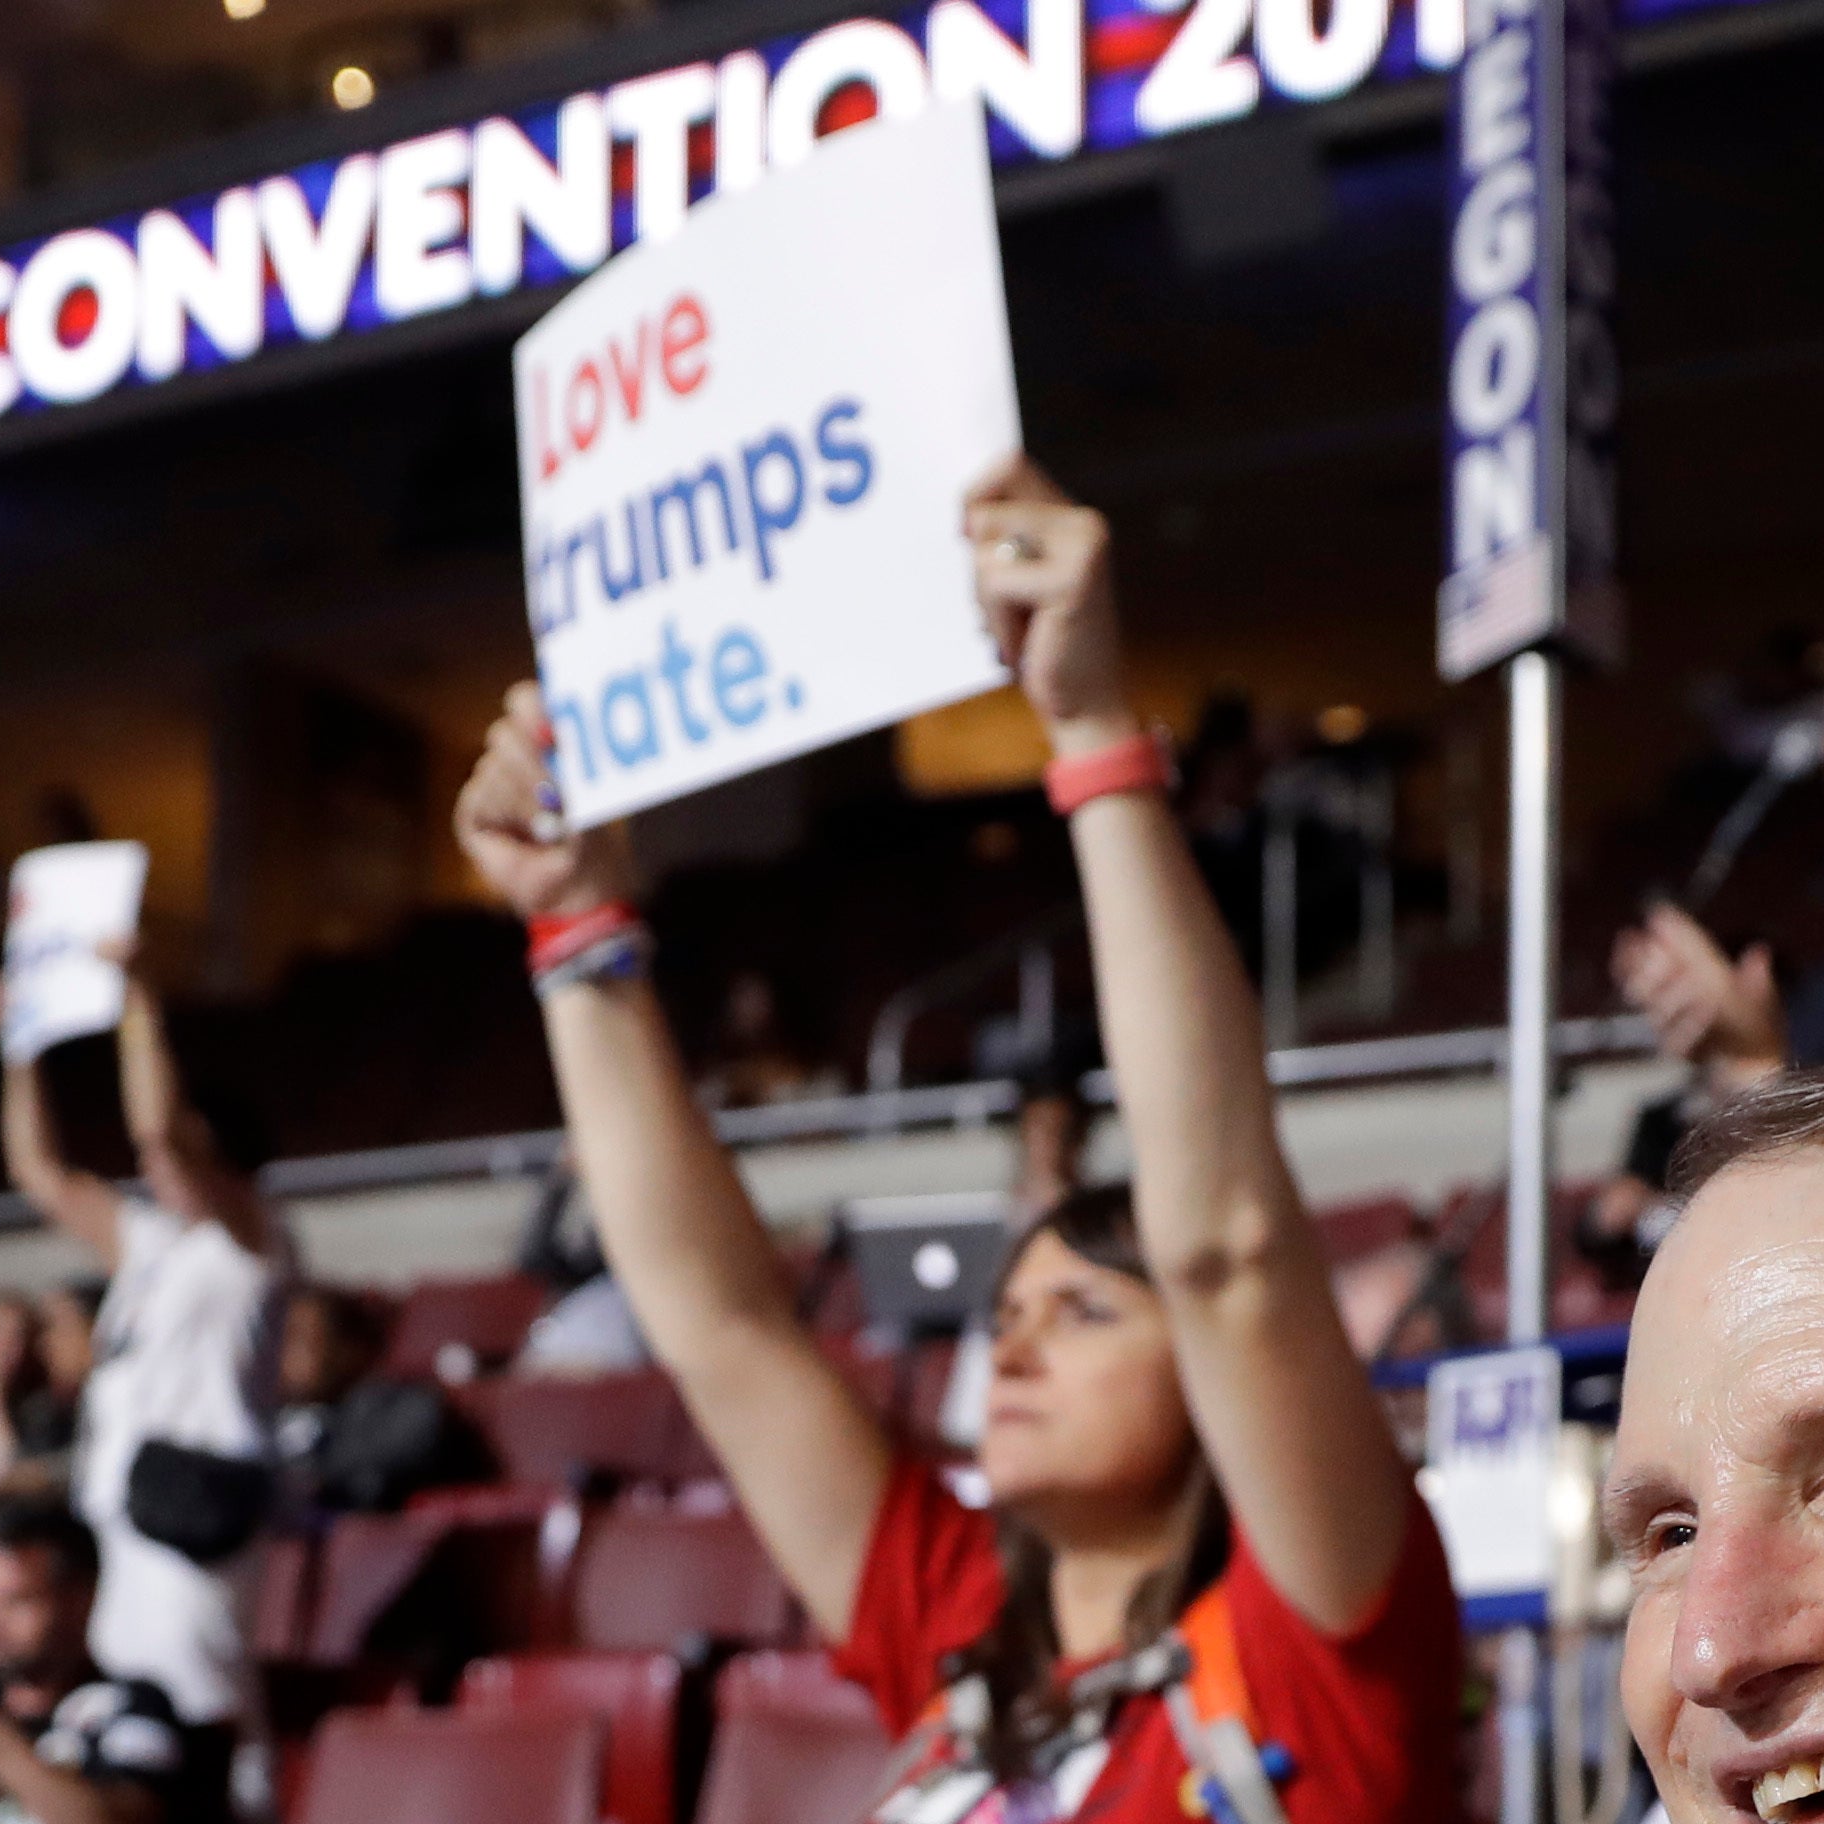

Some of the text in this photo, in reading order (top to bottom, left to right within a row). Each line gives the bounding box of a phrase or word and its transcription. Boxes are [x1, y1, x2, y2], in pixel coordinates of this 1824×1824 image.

[533, 292, 711, 482] Love
[1448, 0, 1542, 574] EGON
[530, 394, 878, 638] trumps
